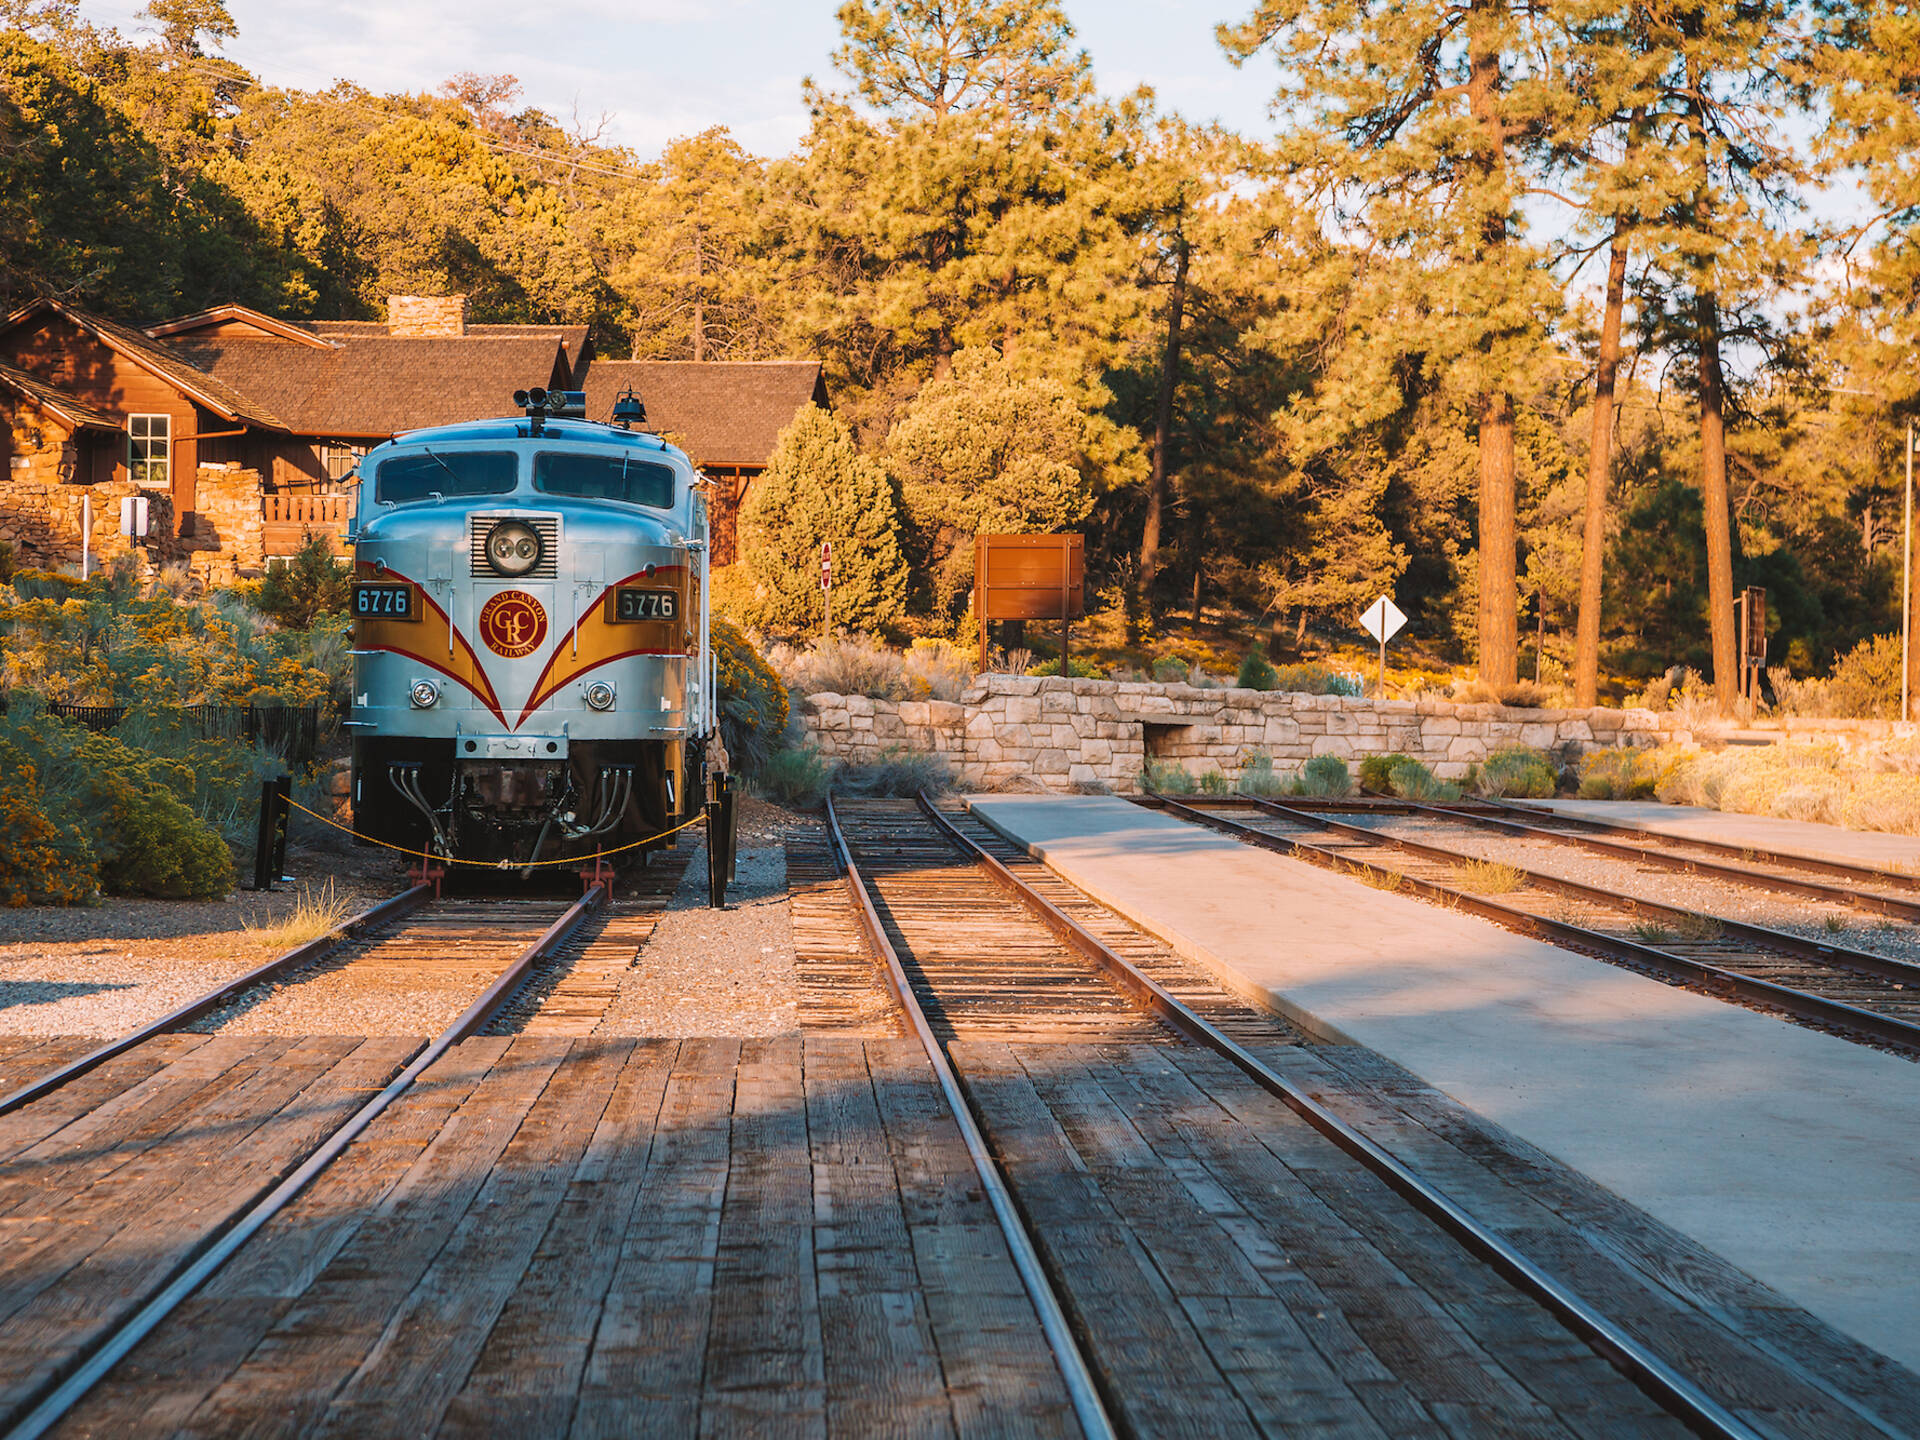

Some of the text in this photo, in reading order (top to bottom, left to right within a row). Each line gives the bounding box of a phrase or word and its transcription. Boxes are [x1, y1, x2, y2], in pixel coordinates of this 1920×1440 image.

[358, 590, 406, 612] 6776
[481, 591, 546, 623] GRAND CANYON
[623, 593, 673, 617] 6776
[490, 641, 536, 657] RAILWAY
